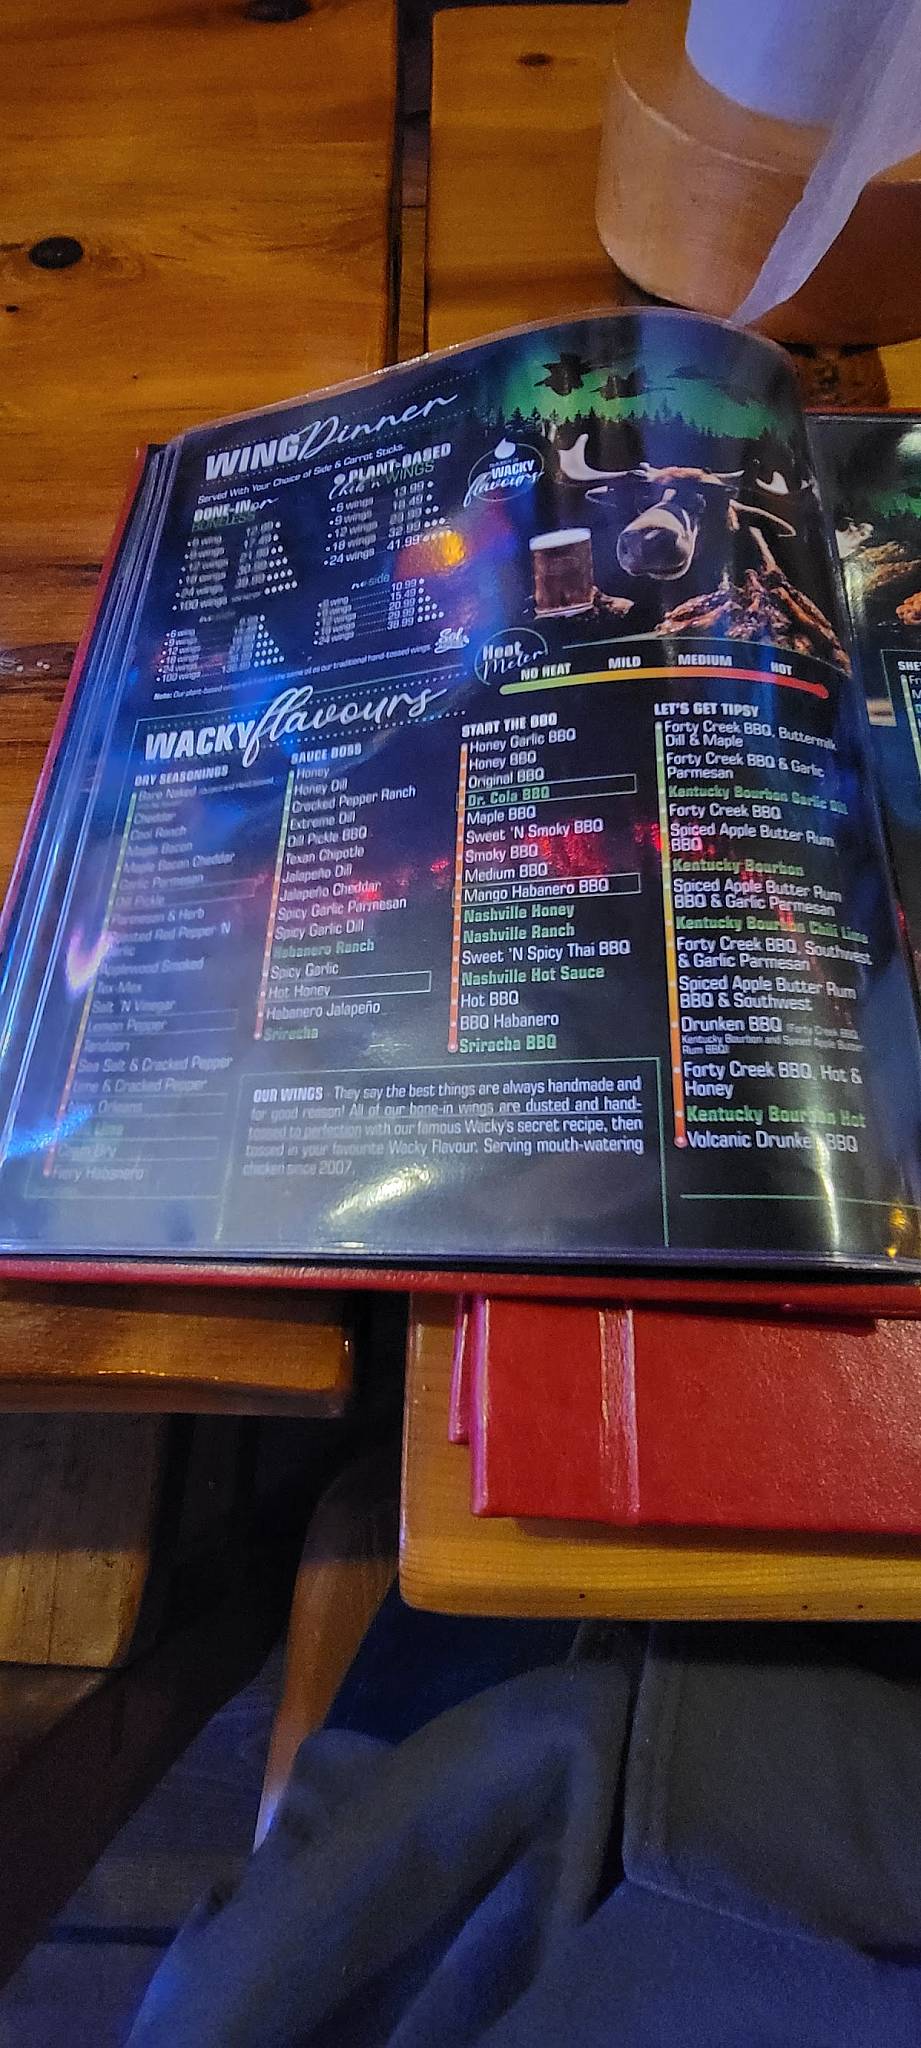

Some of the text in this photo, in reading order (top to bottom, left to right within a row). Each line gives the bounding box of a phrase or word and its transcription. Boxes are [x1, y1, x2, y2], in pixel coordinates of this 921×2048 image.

[206, 394, 458, 481] WING Dinner
[348, 443, 451, 483] PLANT-BASED
[385, 461, 434, 483] WINGS
[492, 459, 535, 479] WACKY
[198, 490, 228, 504] Served
[229, 486, 250, 498] With
[252, 481, 271, 493] Your
[273, 474, 301, 487] Choice
[302, 469, 312, 479] of
[313, 464, 333, 476] Side
[334, 460, 342, 469] &
[343, 452, 373, 466] Carrot
[194, 499, 252, 521] BONE-IN
[335, 515, 342, 525] 9
[329, 535, 420, 565] 24 wings 41.99
[390, 588, 416, 601] 15.49
[391, 579, 416, 591] 10.99
[388, 608, 414, 620] 29.99
[389, 598, 415, 610] 20.99
[483, 641, 521, 660] Heat
[484, 651, 544, 680] Meter
[521, 654, 792, 681] NO HEAT MILD MEDIUM HOT
[654, 702, 758, 717] LET'S GET TIPSY
[145, 685, 448, 767] WACKY flavours
[461, 712, 558, 738] START THE BBQ
[469, 728, 577, 754] Honey Garlic BBQ
[665, 734, 744, 748] Dill & Maple
[290, 743, 362, 765] SAUCE BOSS
[469, 751, 537, 771] Honey BBQ
[134, 765, 229, 786] DRY SEASONINGS
[468, 767, 545, 789] Original BBQ
[667, 767, 734, 779] Parmesan
[294, 778, 348, 796] Honey Dill
[292, 785, 416, 814] Cracked Pepper Ranch
[290, 811, 355, 830] Extreme Dill
[467, 805, 536, 826] Maple BBQ
[669, 804, 782, 820] Forty Creek BBQ
[287, 826, 367, 848] Dill Pickle BBQ
[670, 823, 835, 847] Spiced Apple Butter Rum
[671, 837, 702, 851] BBQ
[192, 852, 235, 868] Cheddar
[465, 844, 538, 864] Smoky BBQ
[464, 862, 548, 883] Medium BBQ
[672, 858, 805, 877] Kentucky Bourbon
[464, 878, 610, 903] Mango Habanero BBQ
[179, 908, 205, 921] Herb
[277, 898, 407, 922] Spicy Garlic Parmesan
[464, 903, 575, 923] Nashville Honey
[674, 894, 835, 917] BBQ & Garlic Parmesan
[275, 919, 364, 941] Spicy Garlic Dill
[463, 922, 576, 944] Nashville Ranch
[678, 953, 810, 971] & Garlic Parmesan
[461, 965, 605, 986] Nashville Hot Sauce
[268, 983, 331, 999] Hot Honey
[678, 975, 857, 999] Spiced Apple Butter Rum
[680, 993, 813, 1012] BBQ & Southwest
[460, 1012, 559, 1031] BBQ Habanero
[129, 1058, 138, 1071] &
[142, 1056, 188, 1071] Cracked
[192, 1055, 232, 1071] Pepper
[115, 1077, 207, 1092] Cracked Pepper
[253, 1075, 642, 1103] OUR WINGS They say the best things are always handmade and
[685, 1082, 734, 1100] Honey
[350, 1097, 599, 1117] All wings are dusted and
[517, 1115, 642, 1132] secret then
[483, 1137, 644, 1155] Serving mouth-watering
